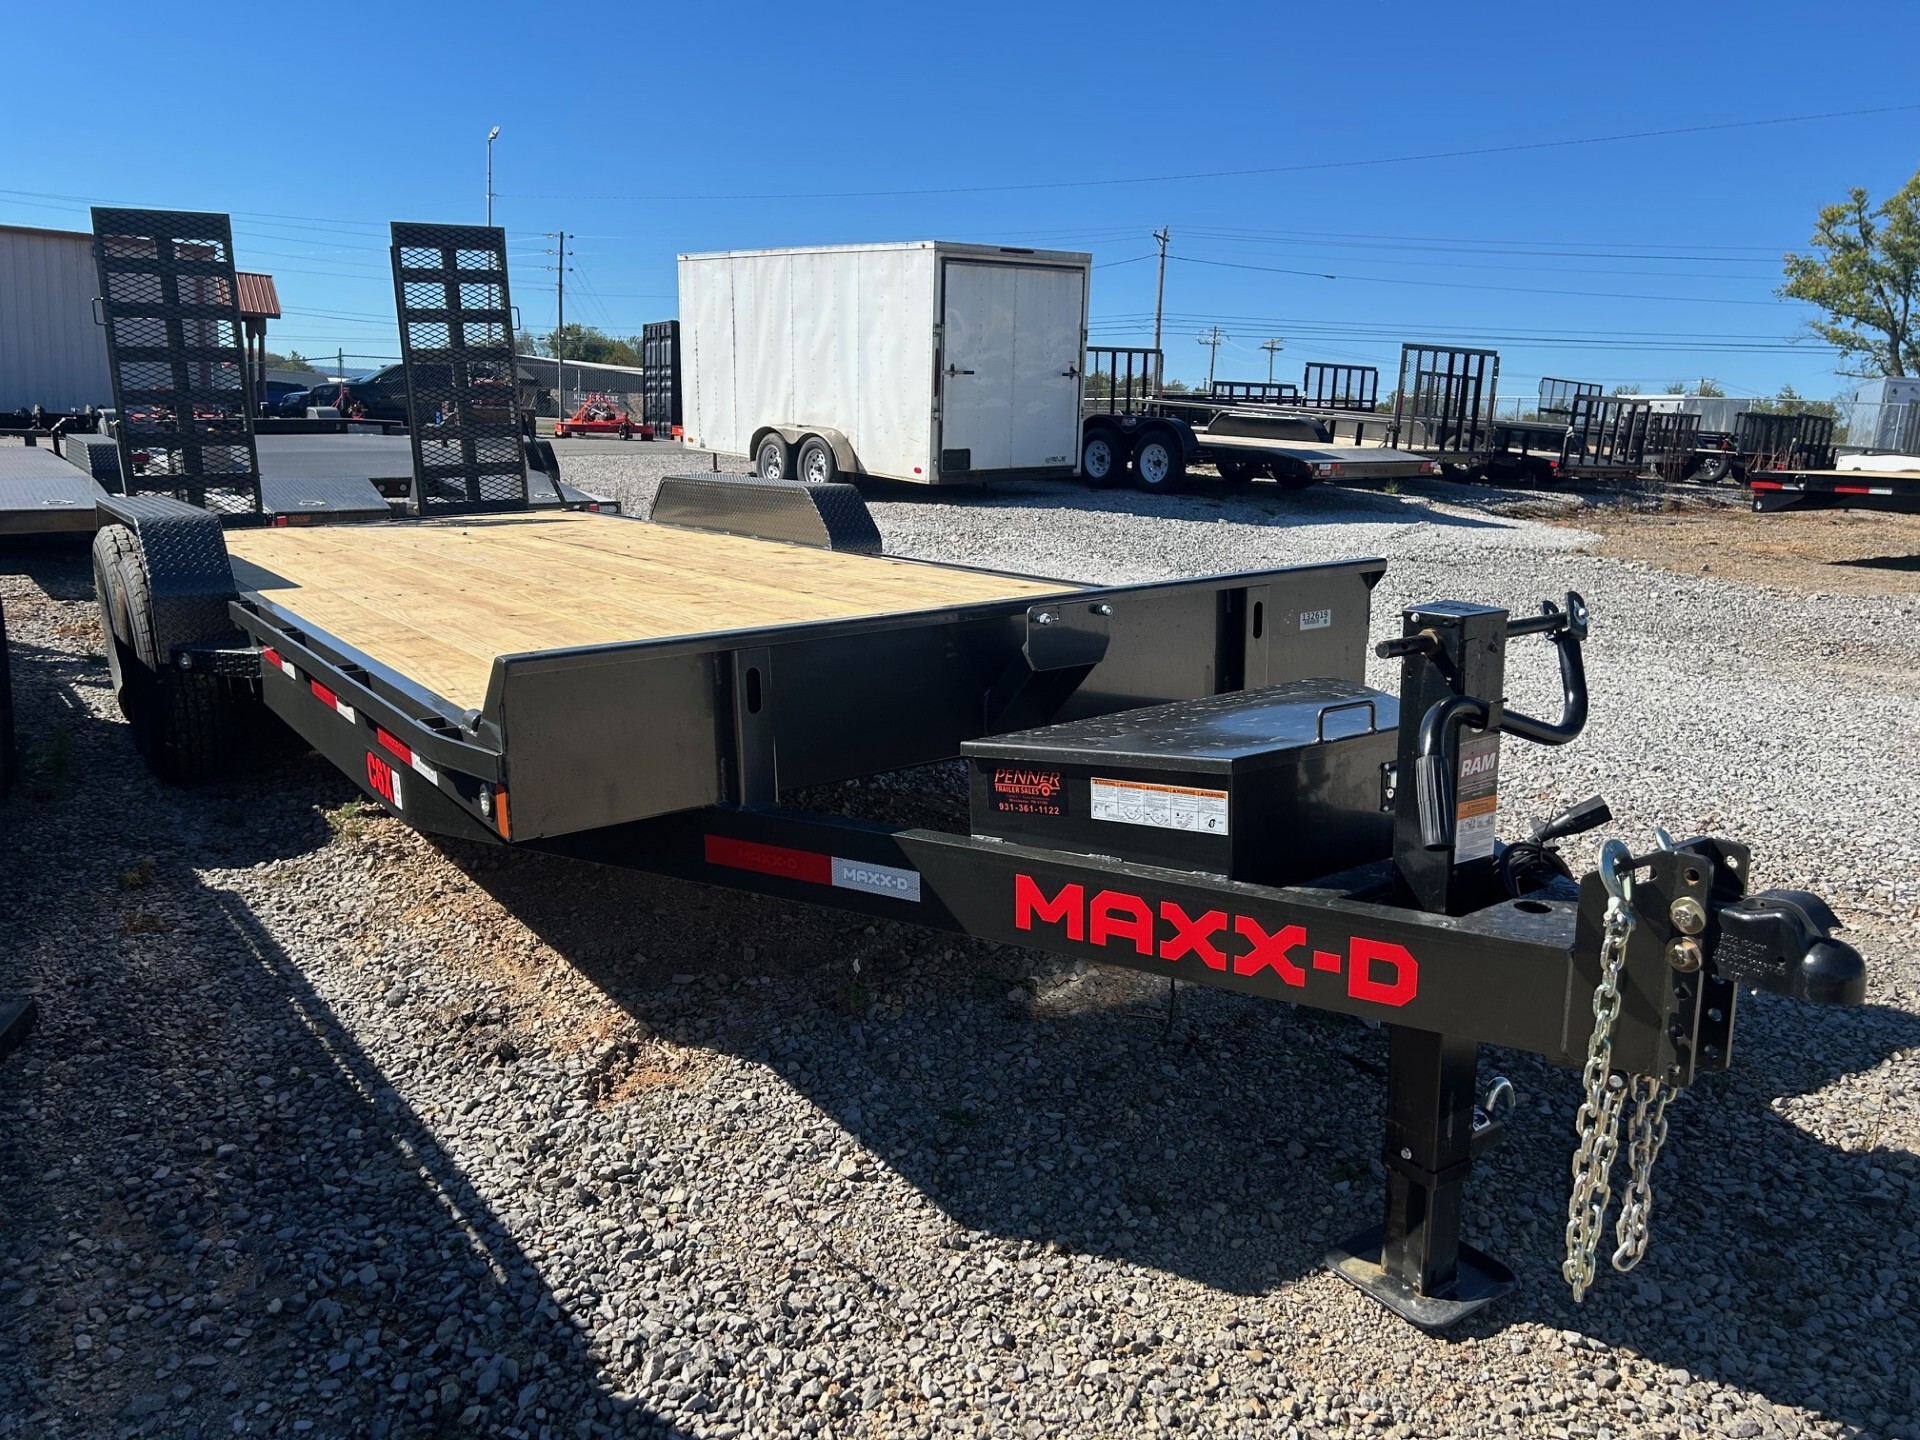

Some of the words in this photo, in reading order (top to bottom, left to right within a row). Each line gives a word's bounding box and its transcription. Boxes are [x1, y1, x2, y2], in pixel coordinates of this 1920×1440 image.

[1302, 610, 1329, 621] 132619
[1461, 752, 1496, 777] RAM
[366, 751, 395, 804] C6X
[994, 769, 1060, 787] PENNER
[995, 785, 1020, 794] TRAILER
[1020, 786, 1040, 795] SALES
[998, 802, 1060, 815] 931-361-1122
[738, 848, 798, 870] MAXX-D
[843, 867, 908, 891] MAXX-D
[1015, 873, 1419, 1007] MAXX-D
